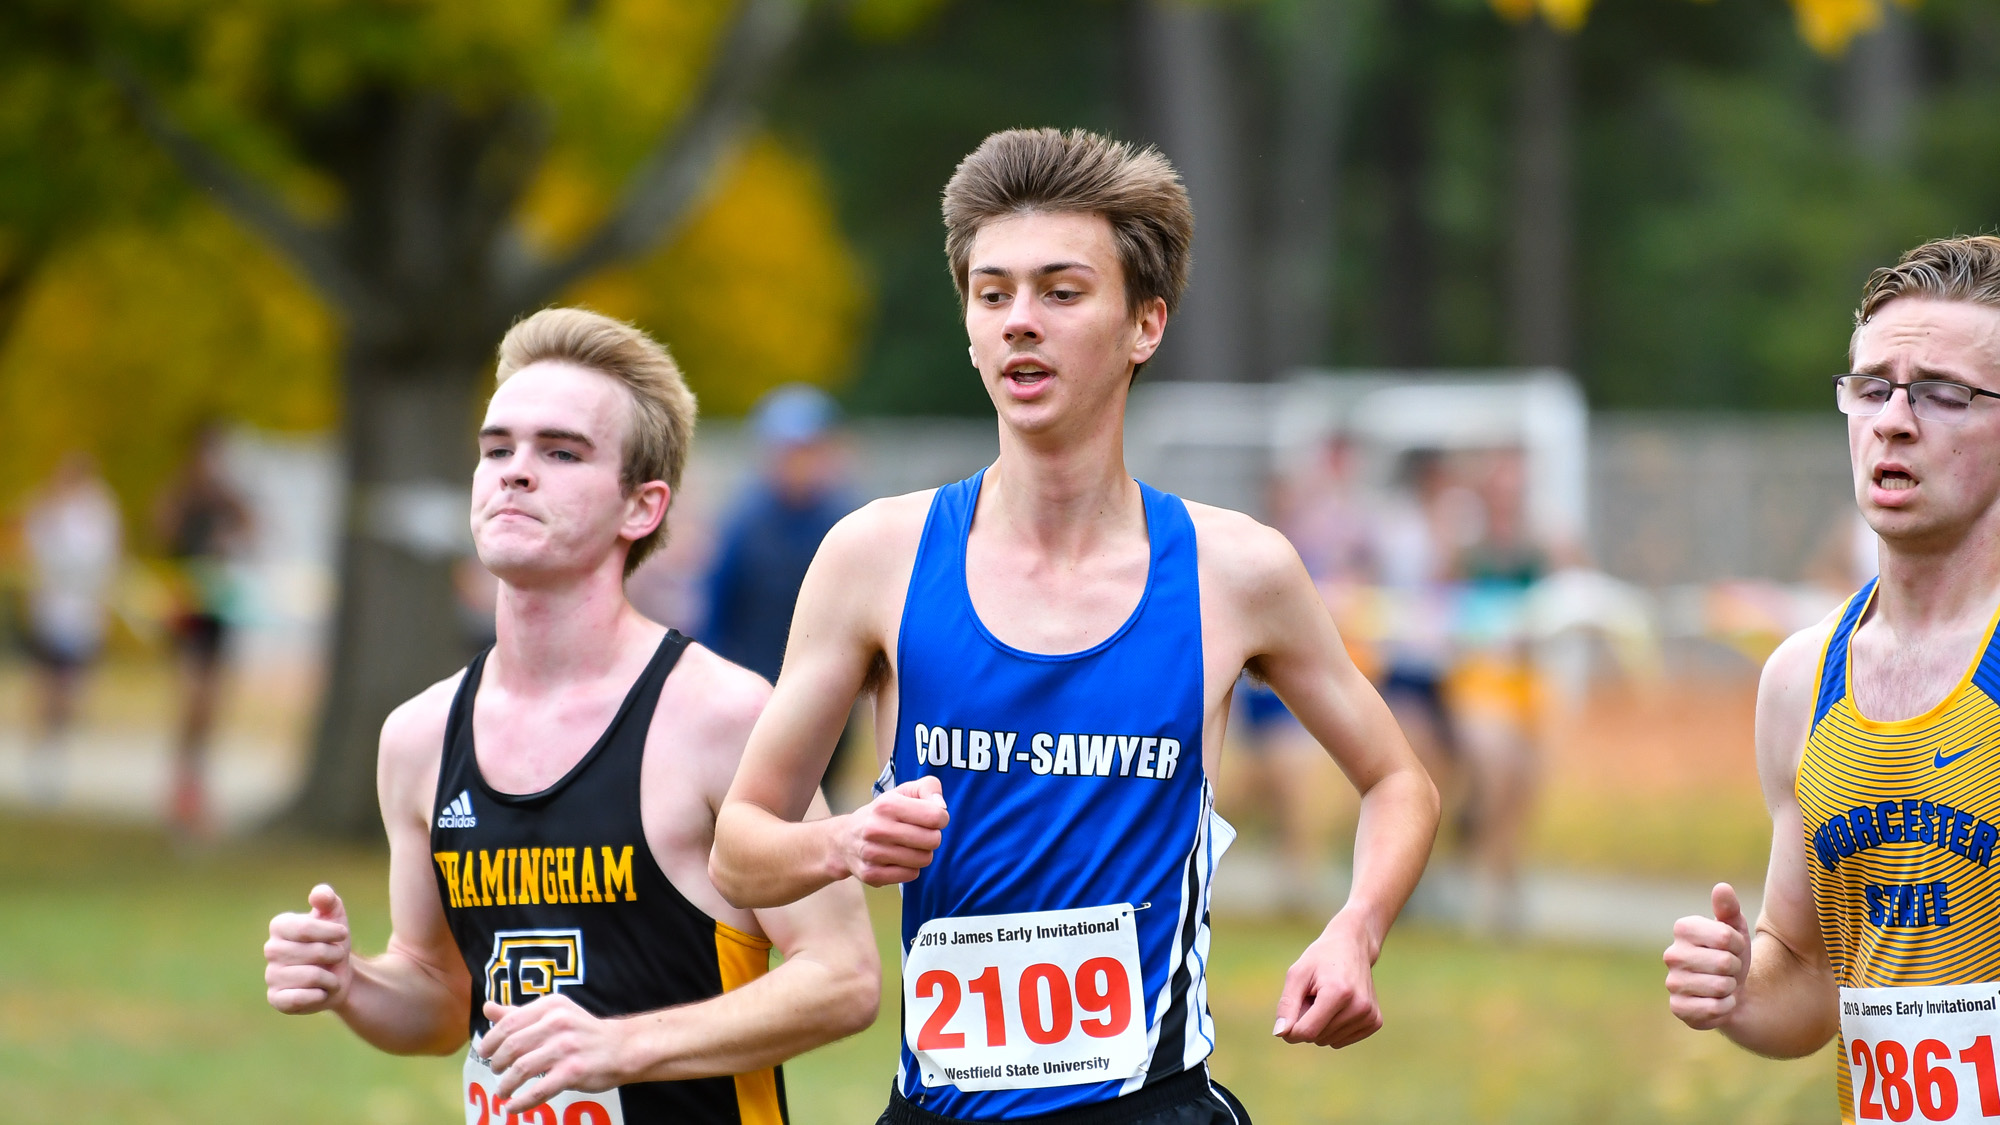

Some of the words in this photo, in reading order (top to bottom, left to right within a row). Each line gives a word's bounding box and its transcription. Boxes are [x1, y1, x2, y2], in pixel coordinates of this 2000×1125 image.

[914, 722, 1182, 780] COLBY-SAWYER
[437, 815, 476, 829] adidas
[1812, 799, 1999, 873] WORCESTER
[1865, 882, 1950, 928] STATE
[919, 931, 947, 947] 2019
[950, 930, 993, 945] James
[997, 927, 1032, 943] Early
[1036, 918, 1120, 939] Invitational
[915, 956, 1132, 1051] 2109
[1843, 1001, 1860, 1016] 2019
[1861, 1002, 1892, 1016] James
[1895, 1001, 1924, 1017] Early
[1926, 996, 1996, 1014] Invitational
[944, 1065, 1002, 1080] Westfield
[1005, 1063, 1040, 1077] State
[1043, 1056, 1110, 1074] University
[1851, 1035, 2000, 1122] 2861
